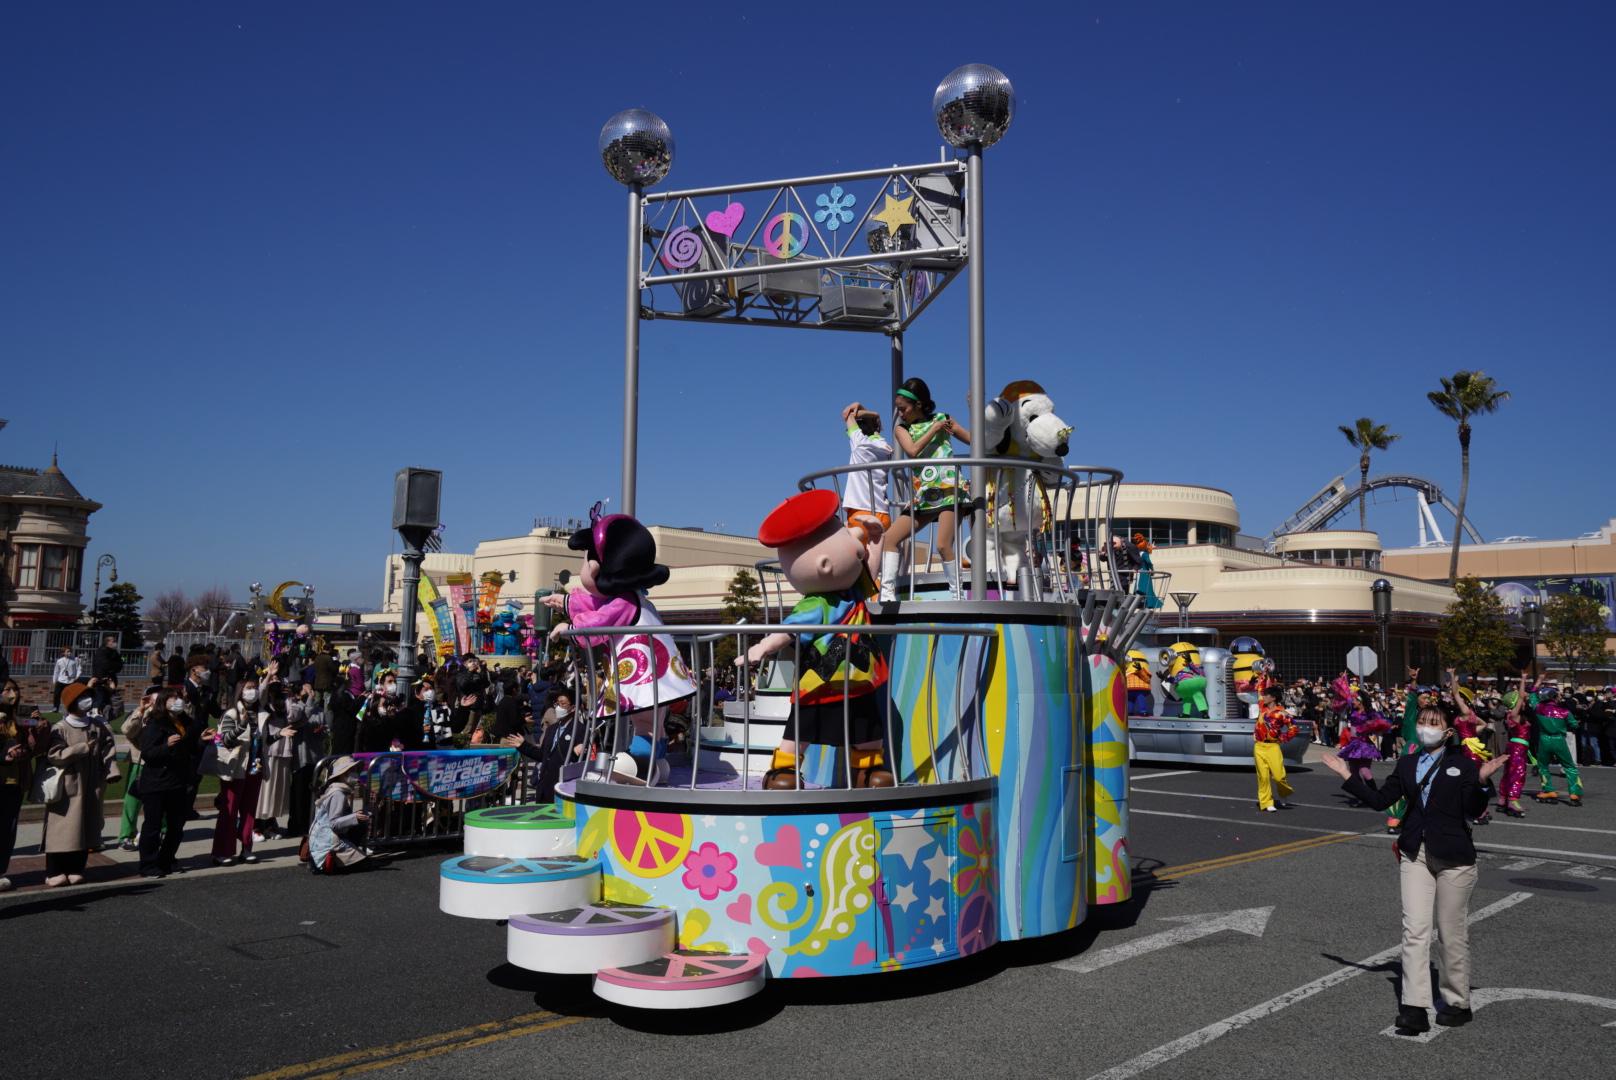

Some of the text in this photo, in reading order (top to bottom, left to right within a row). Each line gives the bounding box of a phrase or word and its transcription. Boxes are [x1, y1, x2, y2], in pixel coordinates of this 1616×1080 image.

[445, 757, 482, 770] NO LIMIT!
[430, 761, 493, 786] Parade
[433, 775, 492, 794] DANCE! DANCE! DANCE!
